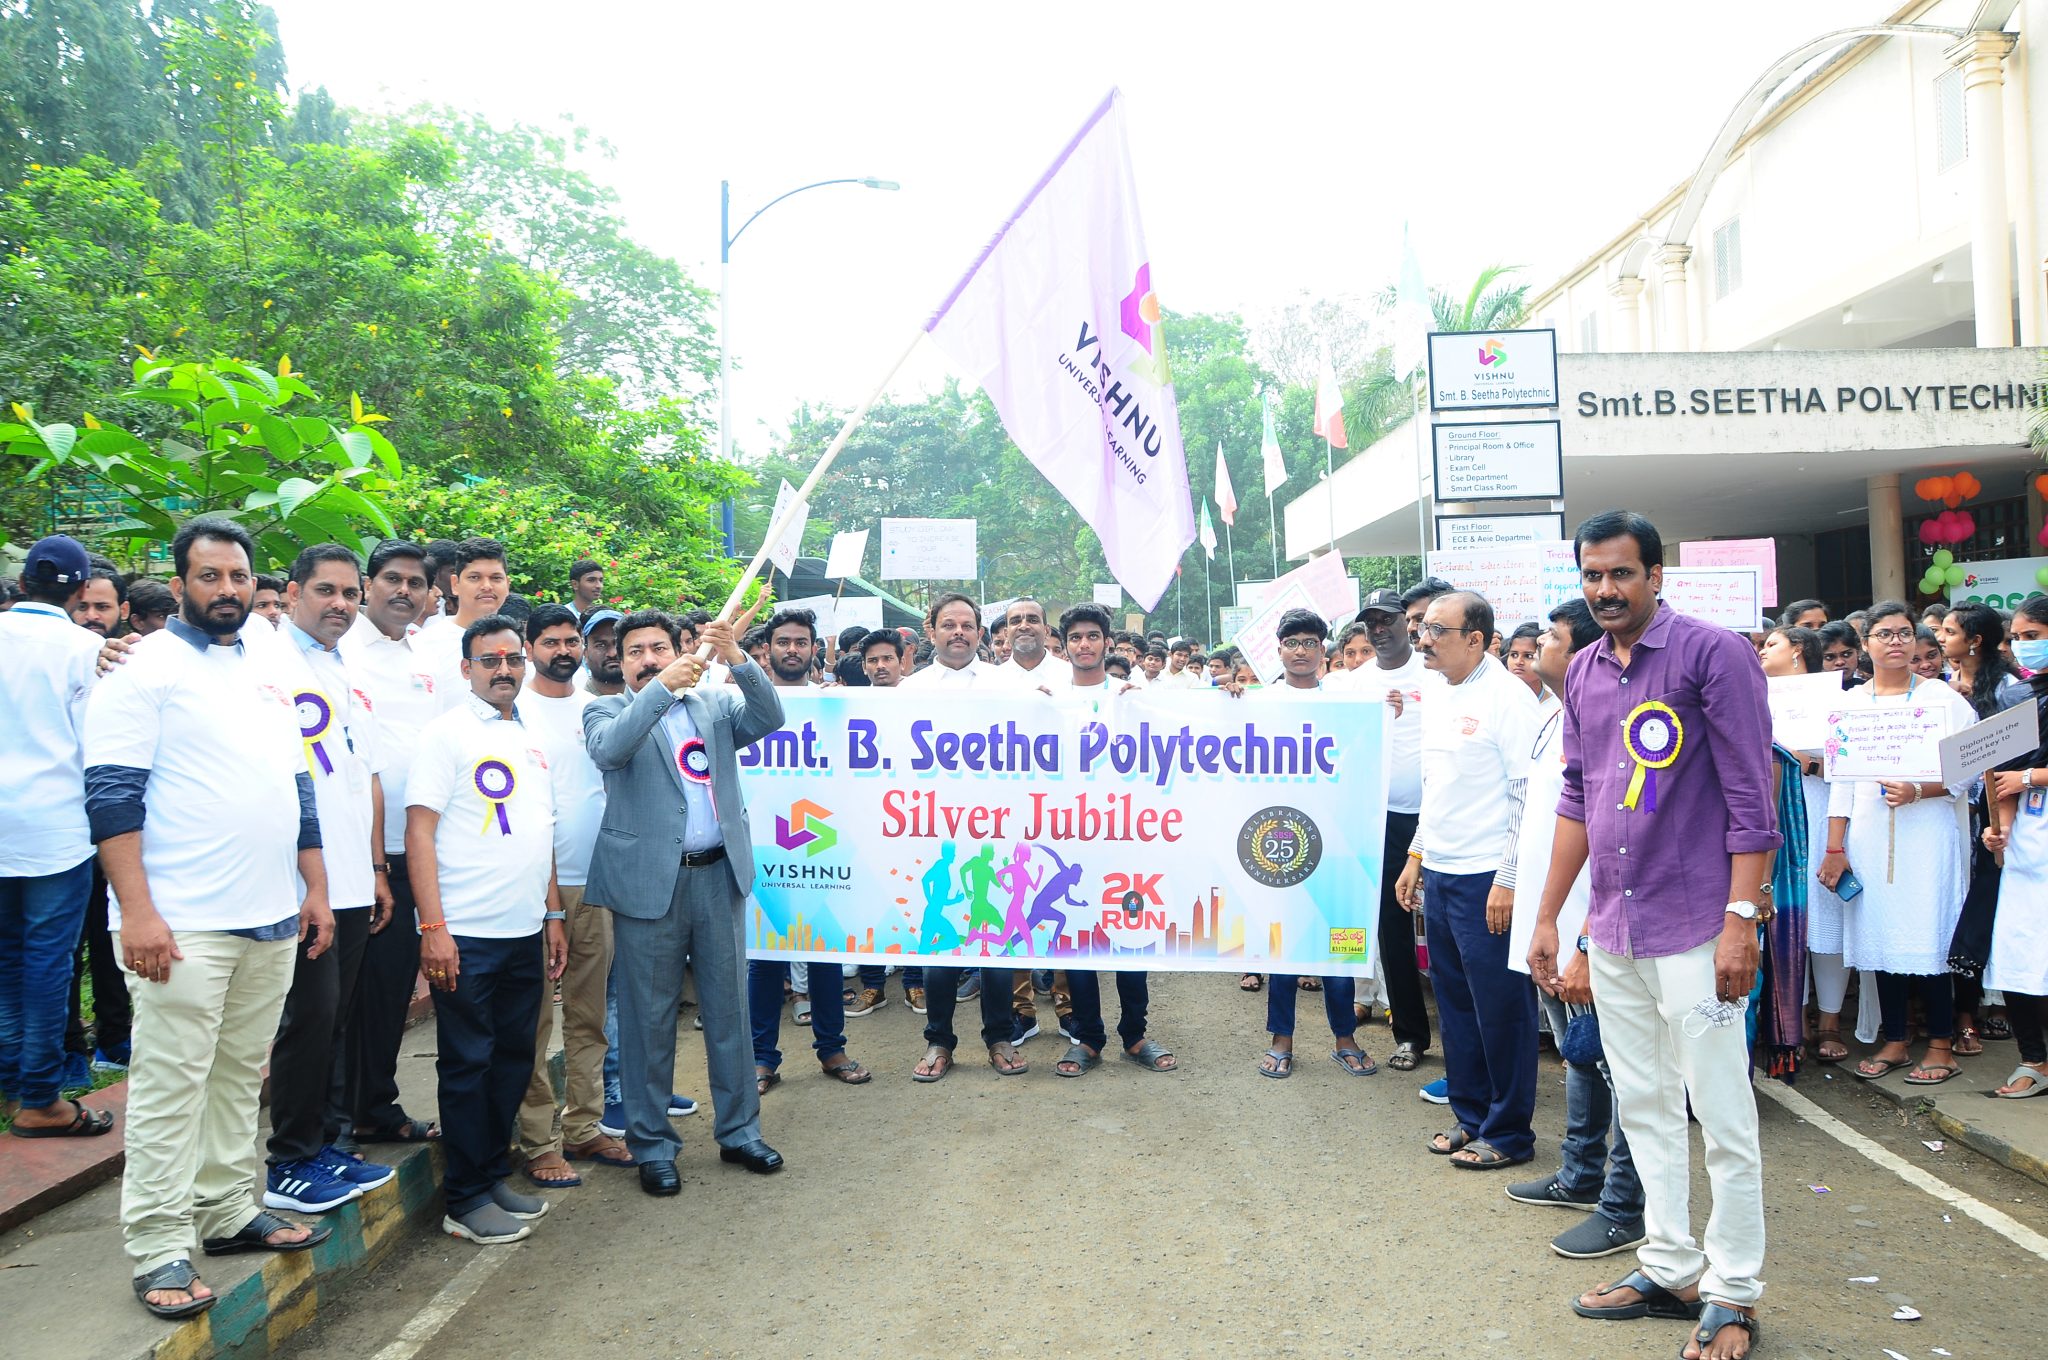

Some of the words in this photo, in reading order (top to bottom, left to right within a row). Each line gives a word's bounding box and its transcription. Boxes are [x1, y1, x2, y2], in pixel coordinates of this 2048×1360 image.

[1474, 372, 1514, 380] VISHNU
[1076, 320, 1162, 458] VISHNU
[1440, 390, 1457, 401] Smt.
[1460, 390, 1469, 400] B.
[1471, 389, 1500, 400] Seetha
[1502, 387, 1550, 400] Polytechnic
[1448, 432, 1477, 440] Ground
[1448, 444, 1480, 452] Principal
[1449, 454, 1475, 462] Library
[1466, 474, 1508, 482] Department
[1450, 484, 1472, 492] Smart
[1452, 536, 1468, 544] ECE
[1960, 733, 1994, 752] Diploma
[2006, 721, 2020, 731] the
[848, 719, 891, 770] B.
[910, 720, 1059, 772] Seetha
[1080, 721, 1335, 786] Polytechnic
[1960, 746, 1983, 760] Short
[1985, 738, 2000, 749] key
[2002, 734, 2010, 742] to
[1961, 750, 1996, 768] Success
[882, 789, 1011, 840] Silver
[1024, 792, 1183, 843] Jubilee
[1244, 810, 1316, 840] CELEBRATING
[1274, 831, 1294, 839] SBSP
[1265, 840, 1294, 858] 25
[762, 864, 851, 880] VISHNU
[1244, 858, 1314, 884] ANNIVERSARY
[1102, 872, 1165, 906] 2K
[1102, 910, 1166, 930] RUN
